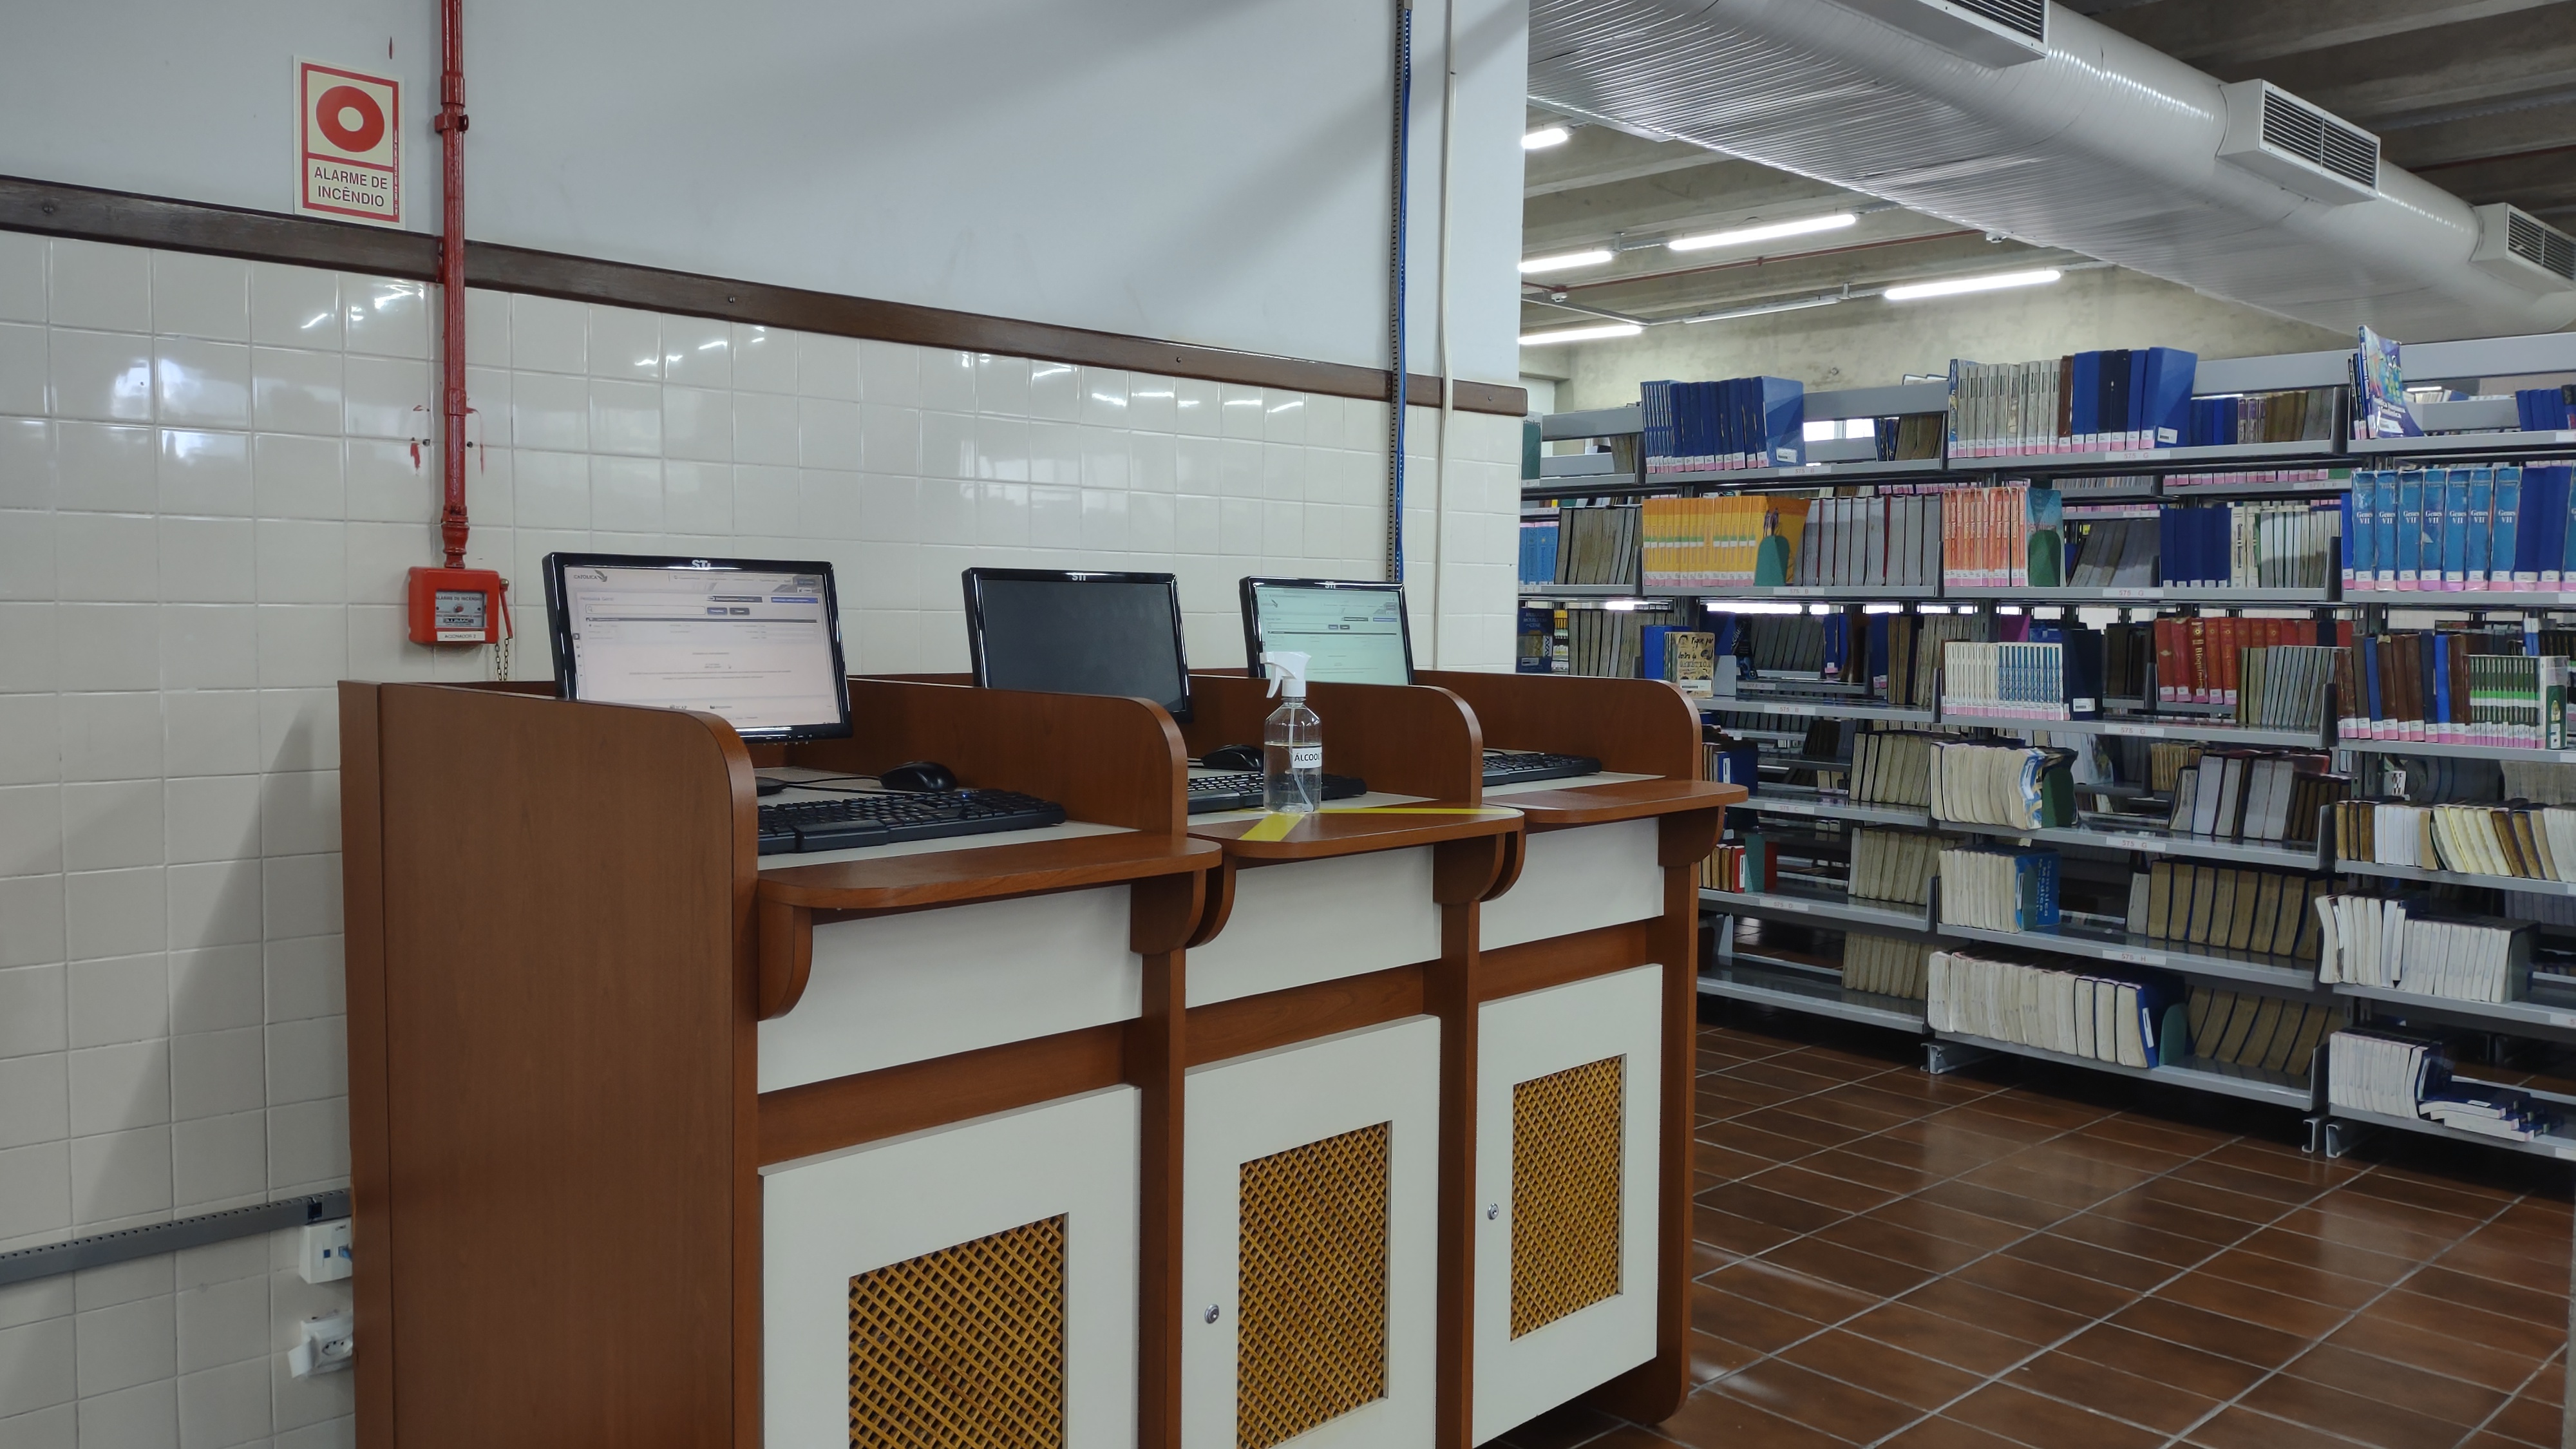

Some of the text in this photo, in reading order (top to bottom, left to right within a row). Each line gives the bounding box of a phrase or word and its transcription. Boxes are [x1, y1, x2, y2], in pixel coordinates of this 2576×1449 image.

[314, 166, 388, 189] ALARME DE
[318, 185, 384, 207] INCÊNDIO
